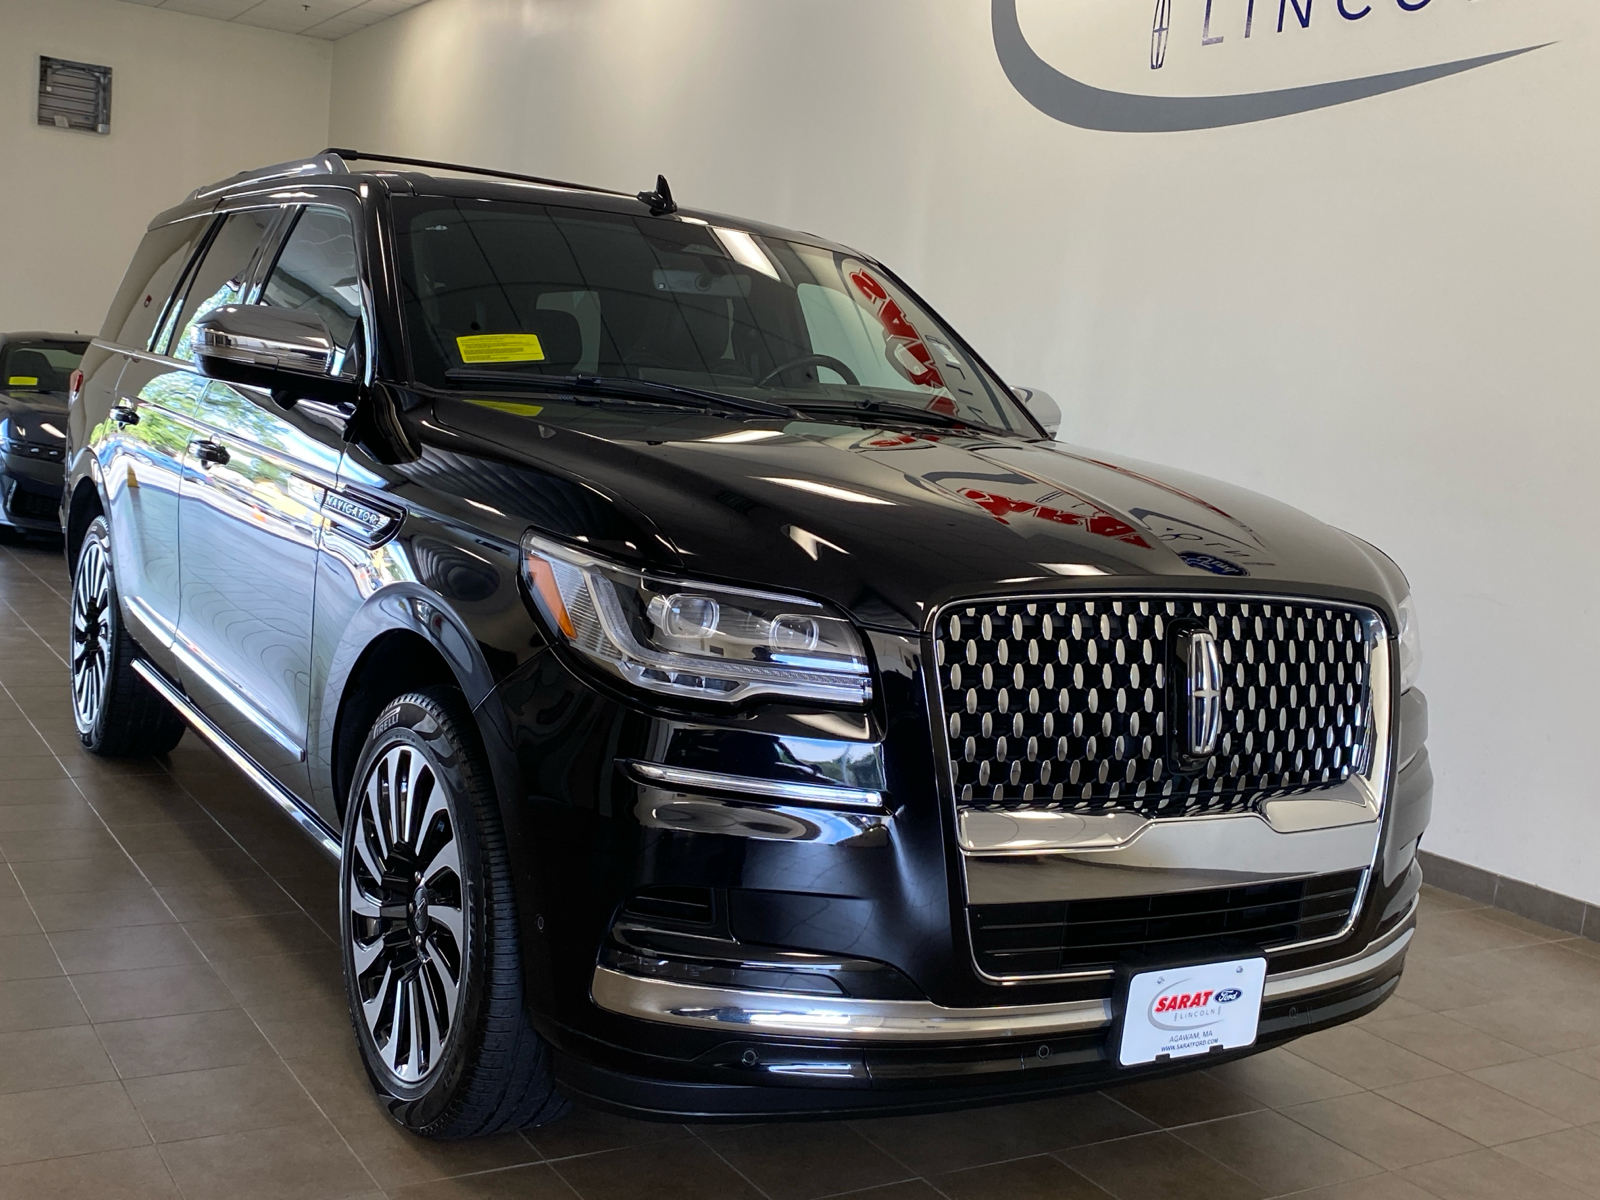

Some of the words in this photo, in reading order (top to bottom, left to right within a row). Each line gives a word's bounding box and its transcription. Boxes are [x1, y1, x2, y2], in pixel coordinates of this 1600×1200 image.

[324, 494, 379, 526] NAVIGATOR
[1155, 989, 1215, 1013] SARAT
[1218, 989, 1239, 1002] Ford
[1179, 1008, 1215, 1019] LINCOLN
[1168, 1031, 1200, 1043] AGAWAM,
[1202, 1030, 1213, 1038] MA
[1161, 1038, 1219, 1052] WWW.SARATFORD.COM
